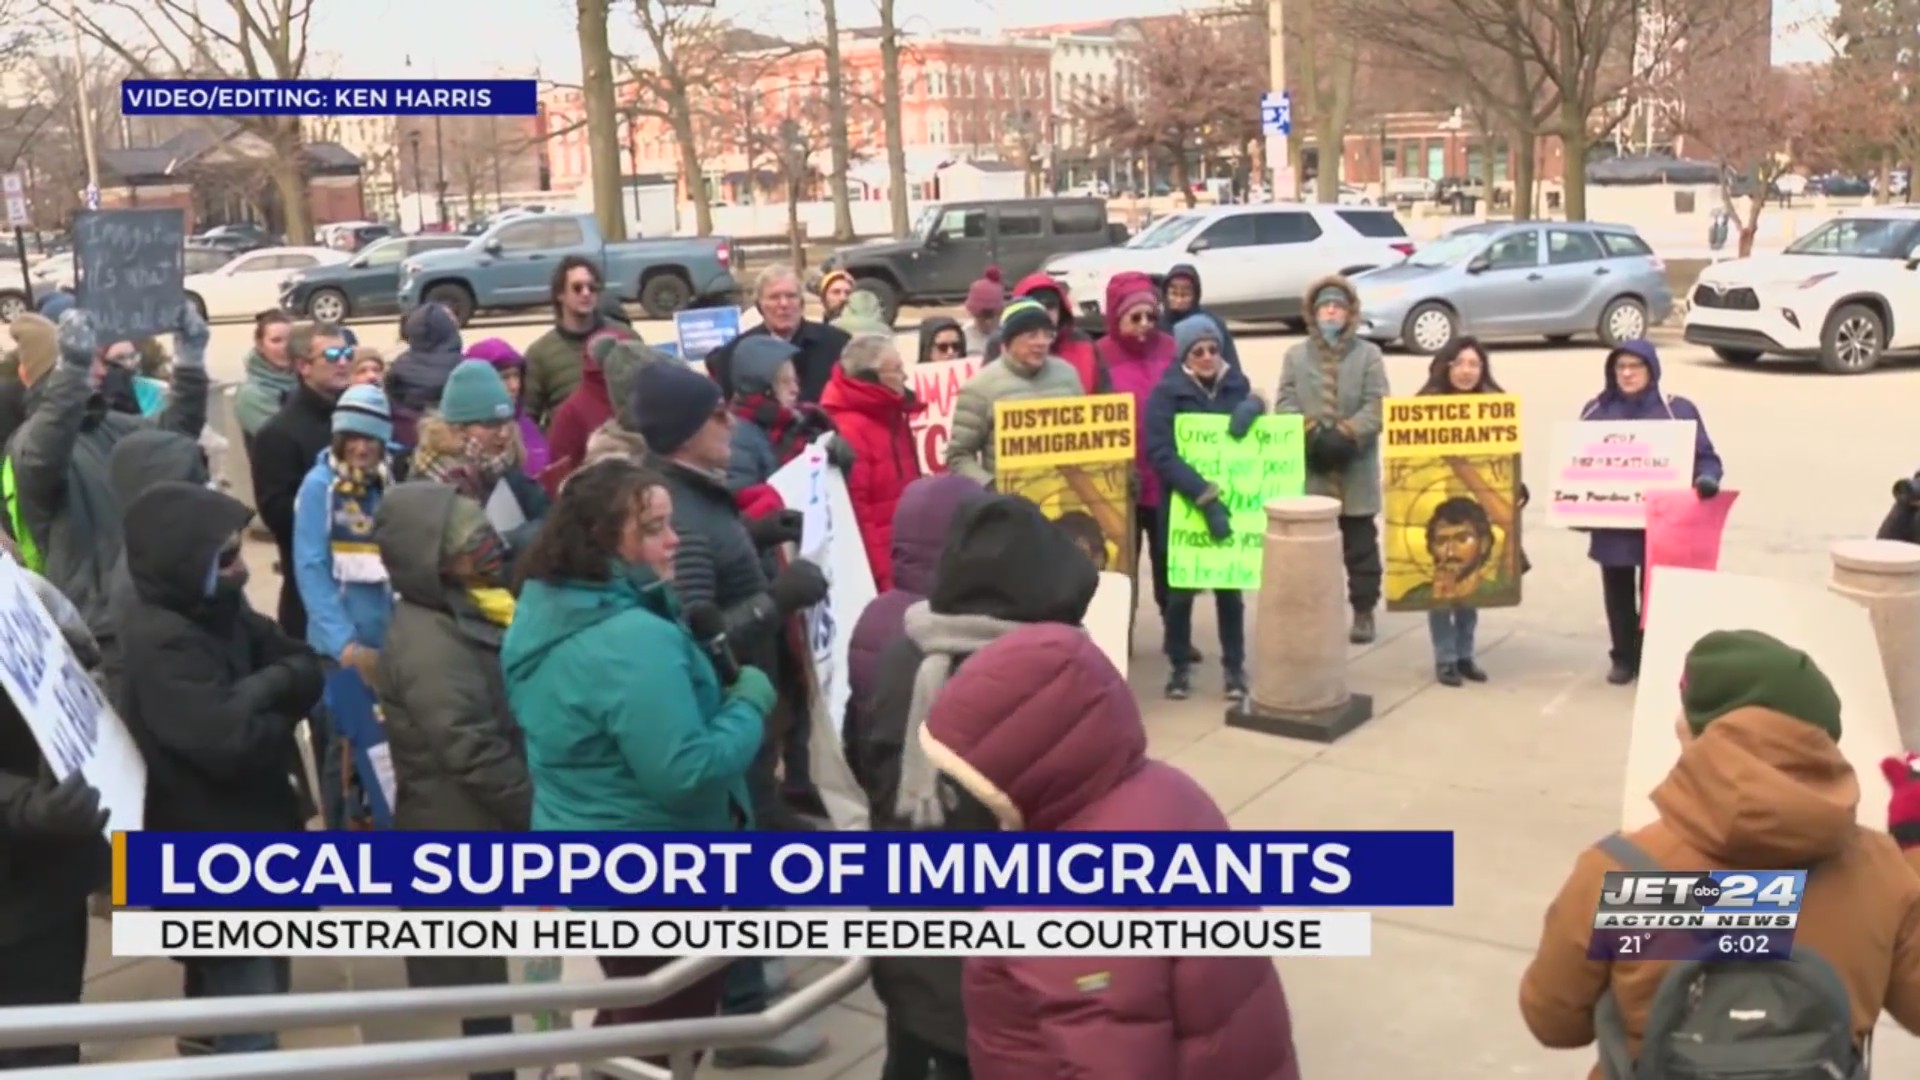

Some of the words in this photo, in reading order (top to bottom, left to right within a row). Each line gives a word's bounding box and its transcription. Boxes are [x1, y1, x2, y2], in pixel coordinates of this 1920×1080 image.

[1002, 405, 1085, 430] JUSTICE
[1091, 402, 1129, 423] FOR
[1388, 403, 1470, 422] JUSTICE
[1478, 401, 1516, 419] FOR
[1001, 428, 1131, 457] IMMIGRANTS
[1388, 425, 1518, 446] IMMIGRANTS
